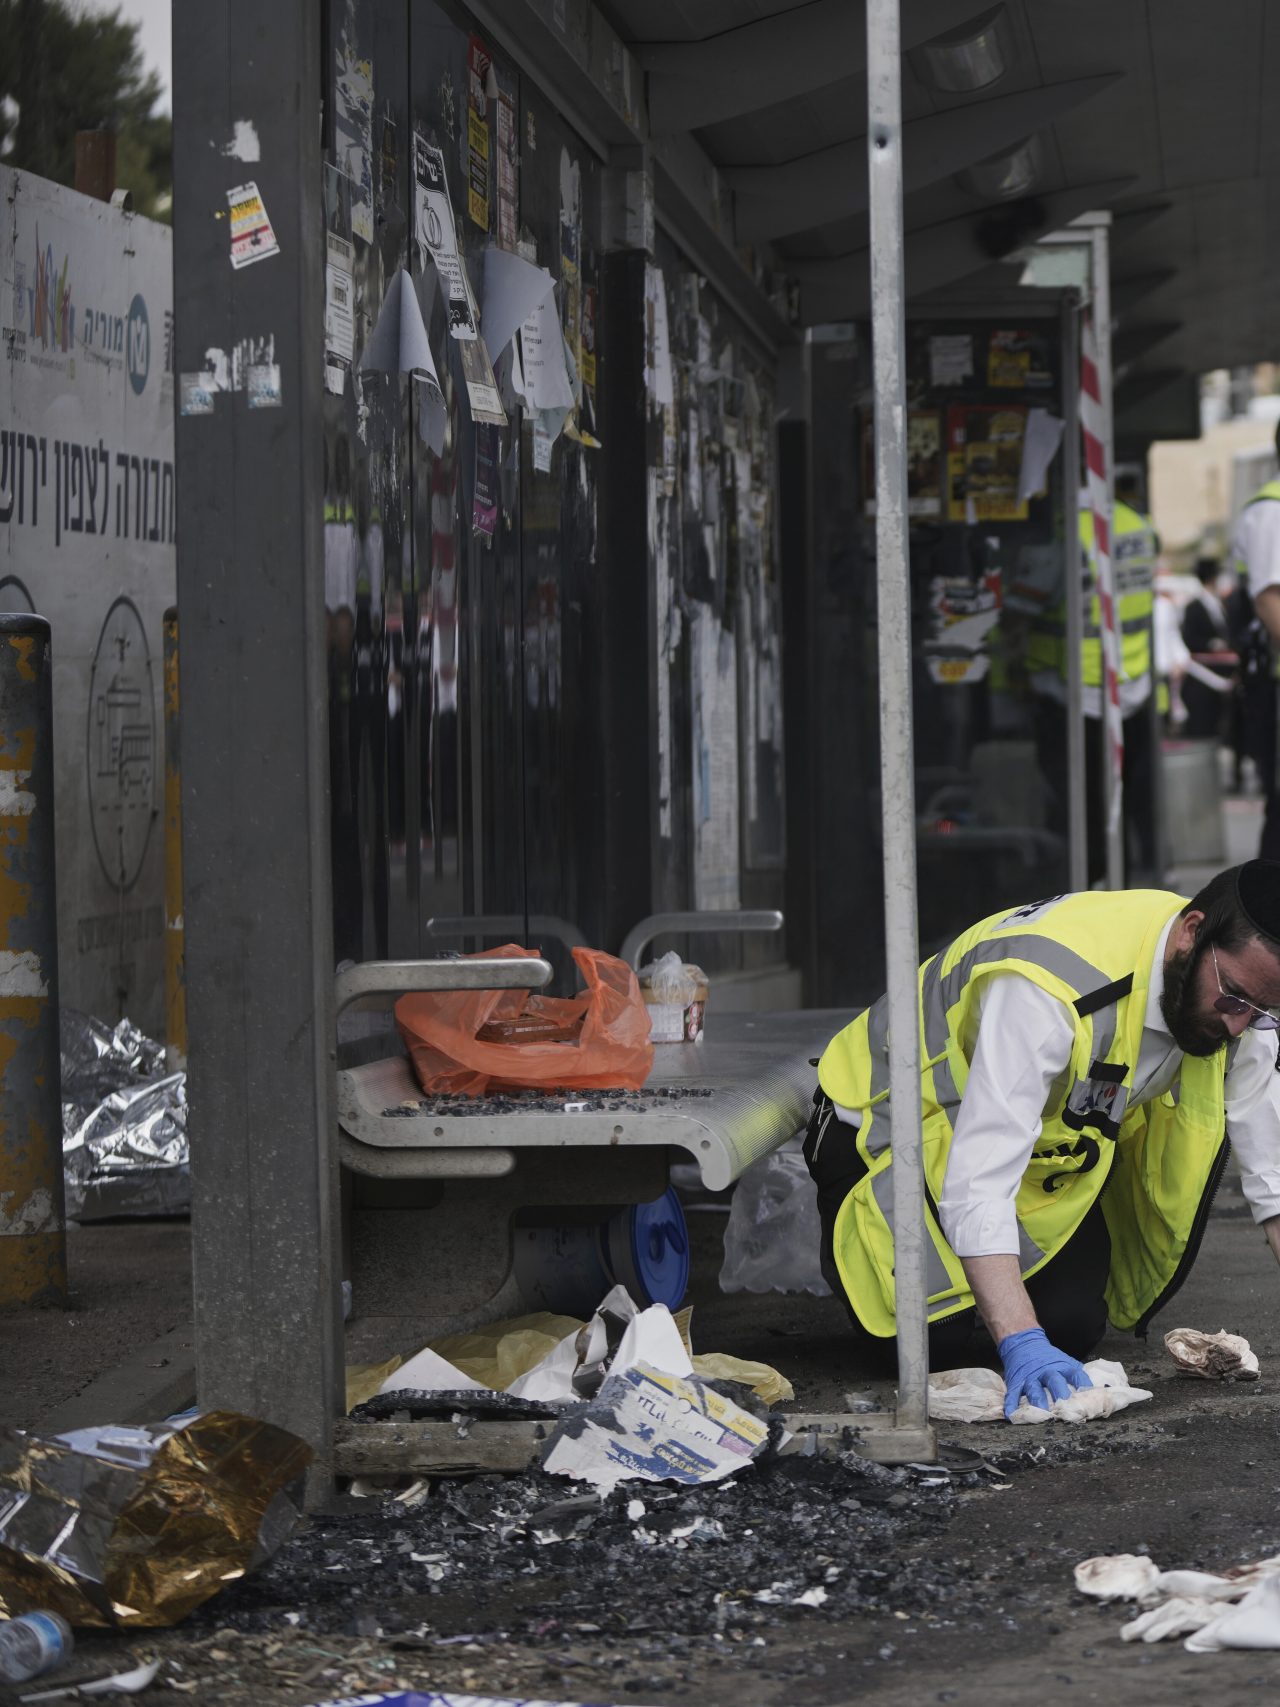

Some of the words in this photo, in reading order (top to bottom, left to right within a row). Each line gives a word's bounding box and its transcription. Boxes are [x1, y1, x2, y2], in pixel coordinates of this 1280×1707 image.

[84, 307, 123, 352] מוריה
[55, 438, 110, 547] לצפון
[116, 452, 176, 544] חבורה
